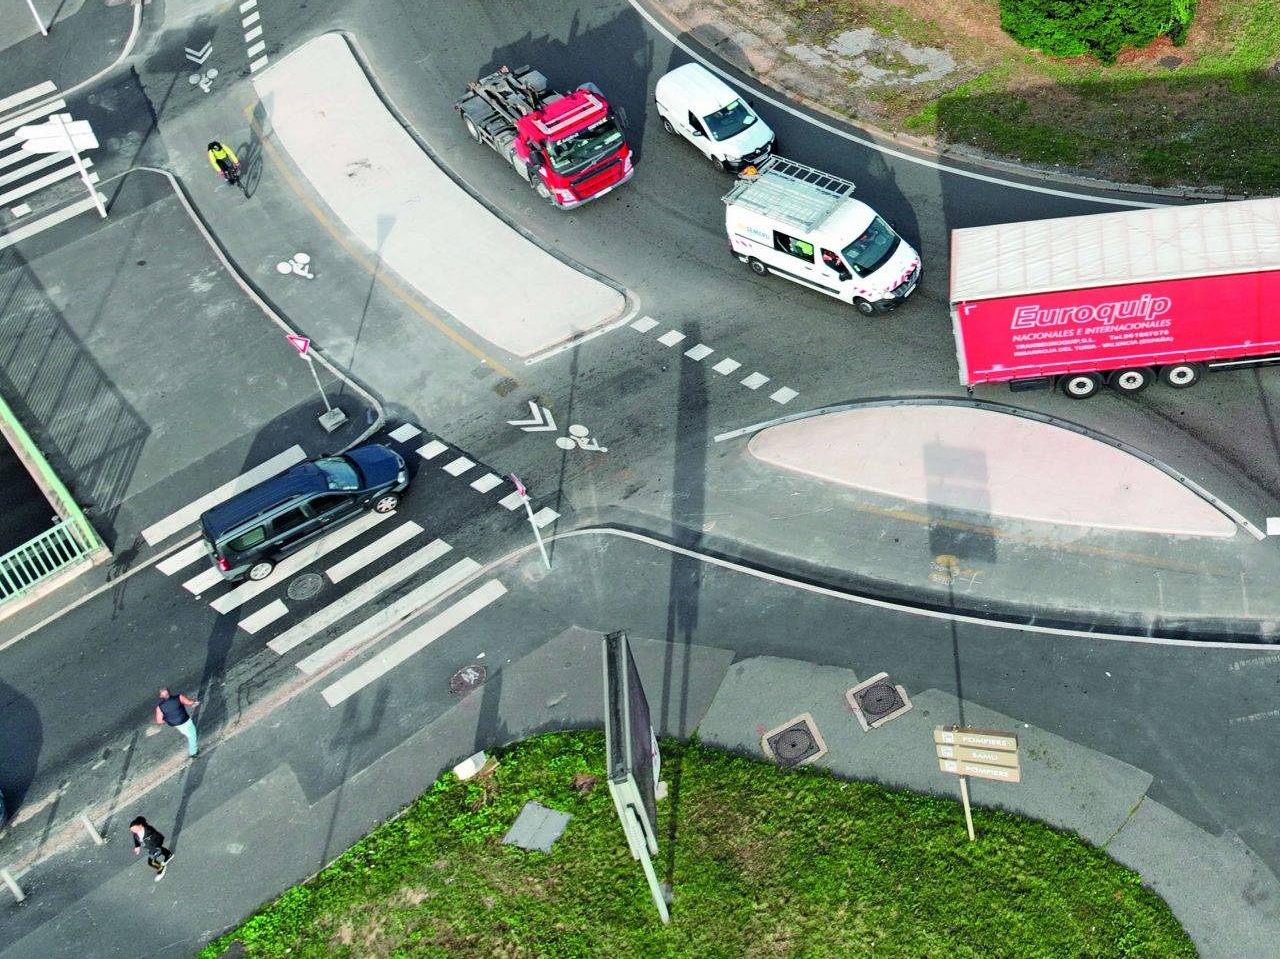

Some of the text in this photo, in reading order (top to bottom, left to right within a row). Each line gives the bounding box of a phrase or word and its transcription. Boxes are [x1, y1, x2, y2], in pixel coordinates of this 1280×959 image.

[1011, 294, 1172, 329] Euroquip
[1012, 329, 1075, 342] NACIONALES
[1085, 319, 1172, 335] INTERNACIONALES
[963, 736, 1008, 746] POMPIERS
[972, 752, 998, 761] SAMU
[965, 765, 1009, 777] POMPIERS
